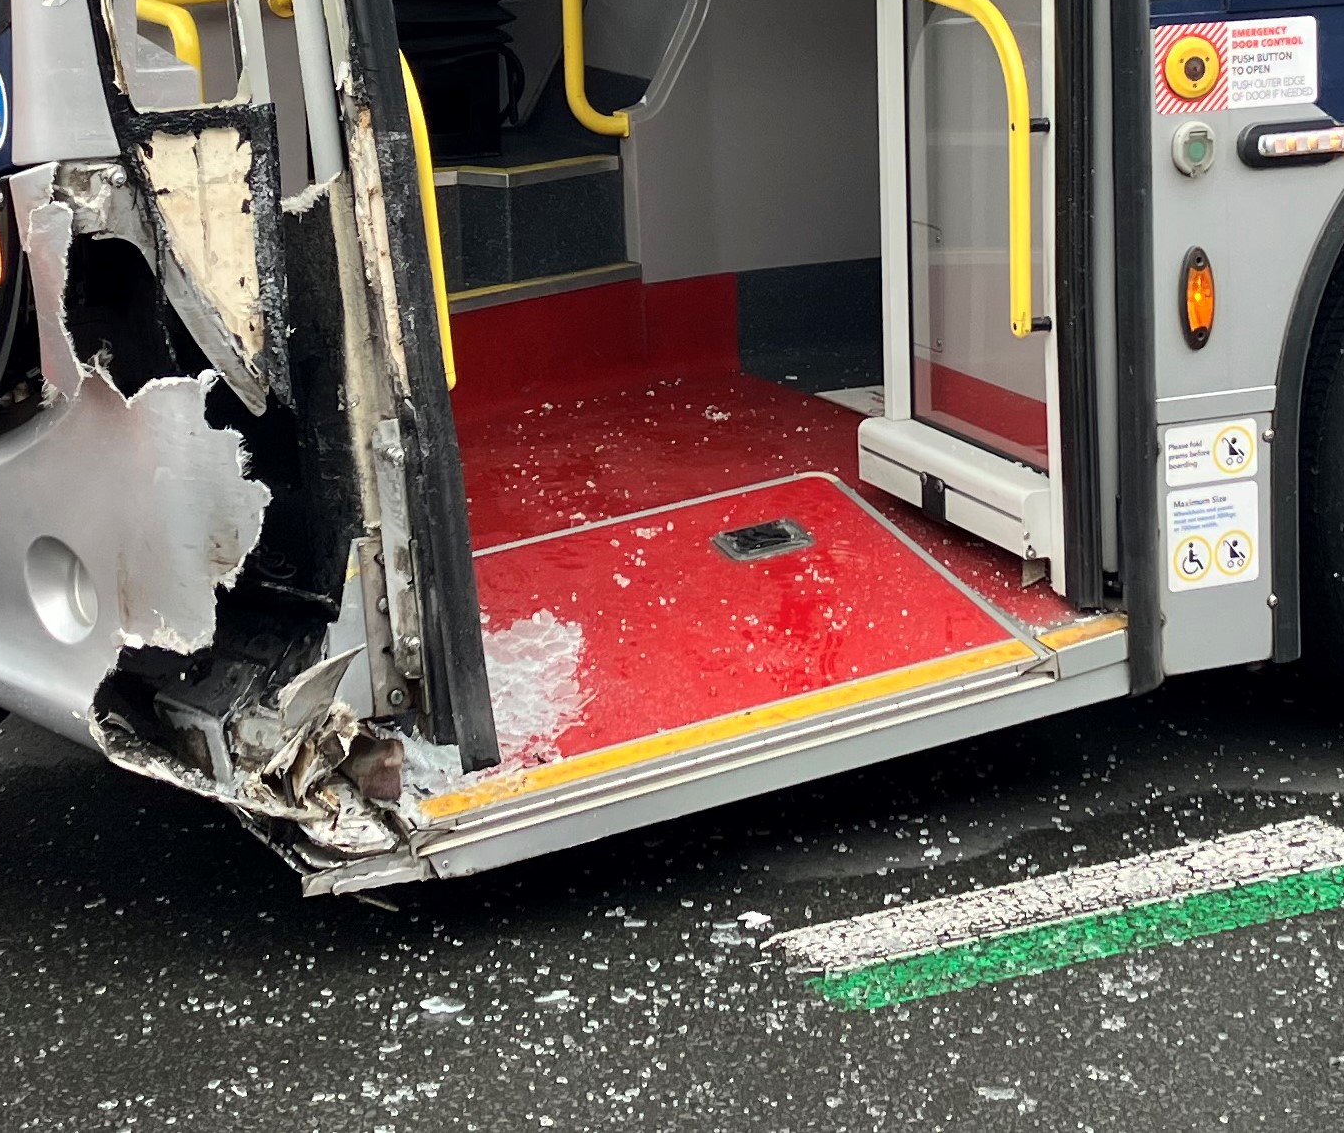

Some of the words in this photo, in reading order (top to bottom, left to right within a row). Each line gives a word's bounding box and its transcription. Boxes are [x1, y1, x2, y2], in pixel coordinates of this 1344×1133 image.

[1231, 26, 1288, 38] EMERGENCY
[1231, 39, 1259, 50] DOOR
[1262, 37, 1303, 48] CONTROL
[1231, 54, 1255, 64] PUSH
[1257, 52, 1293, 62] BUTTON
[1232, 66, 1245, 76] TO
[1245, 65, 1271, 74] OPEN
[1231, 79, 1253, 90] PUSH
[1253, 78, 1282, 89] OUTER
[1283, 76, 1305, 86] EDGE
[1231, 92, 1244, 102] OF
[1245, 90, 1271, 102] DOOR
[1273, 88, 1280, 100] IF
[1281, 86, 1313, 98] NEEDED
[1168, 442, 1189, 452] Please
[1189, 440, 1203, 448] fold
[1168, 452, 1188, 462] prams
[1189, 449, 1211, 458] before
[1169, 460, 1199, 470] boarding
[1173, 498, 1211, 508] Maximum
[1212, 494, 1227, 504] Size
